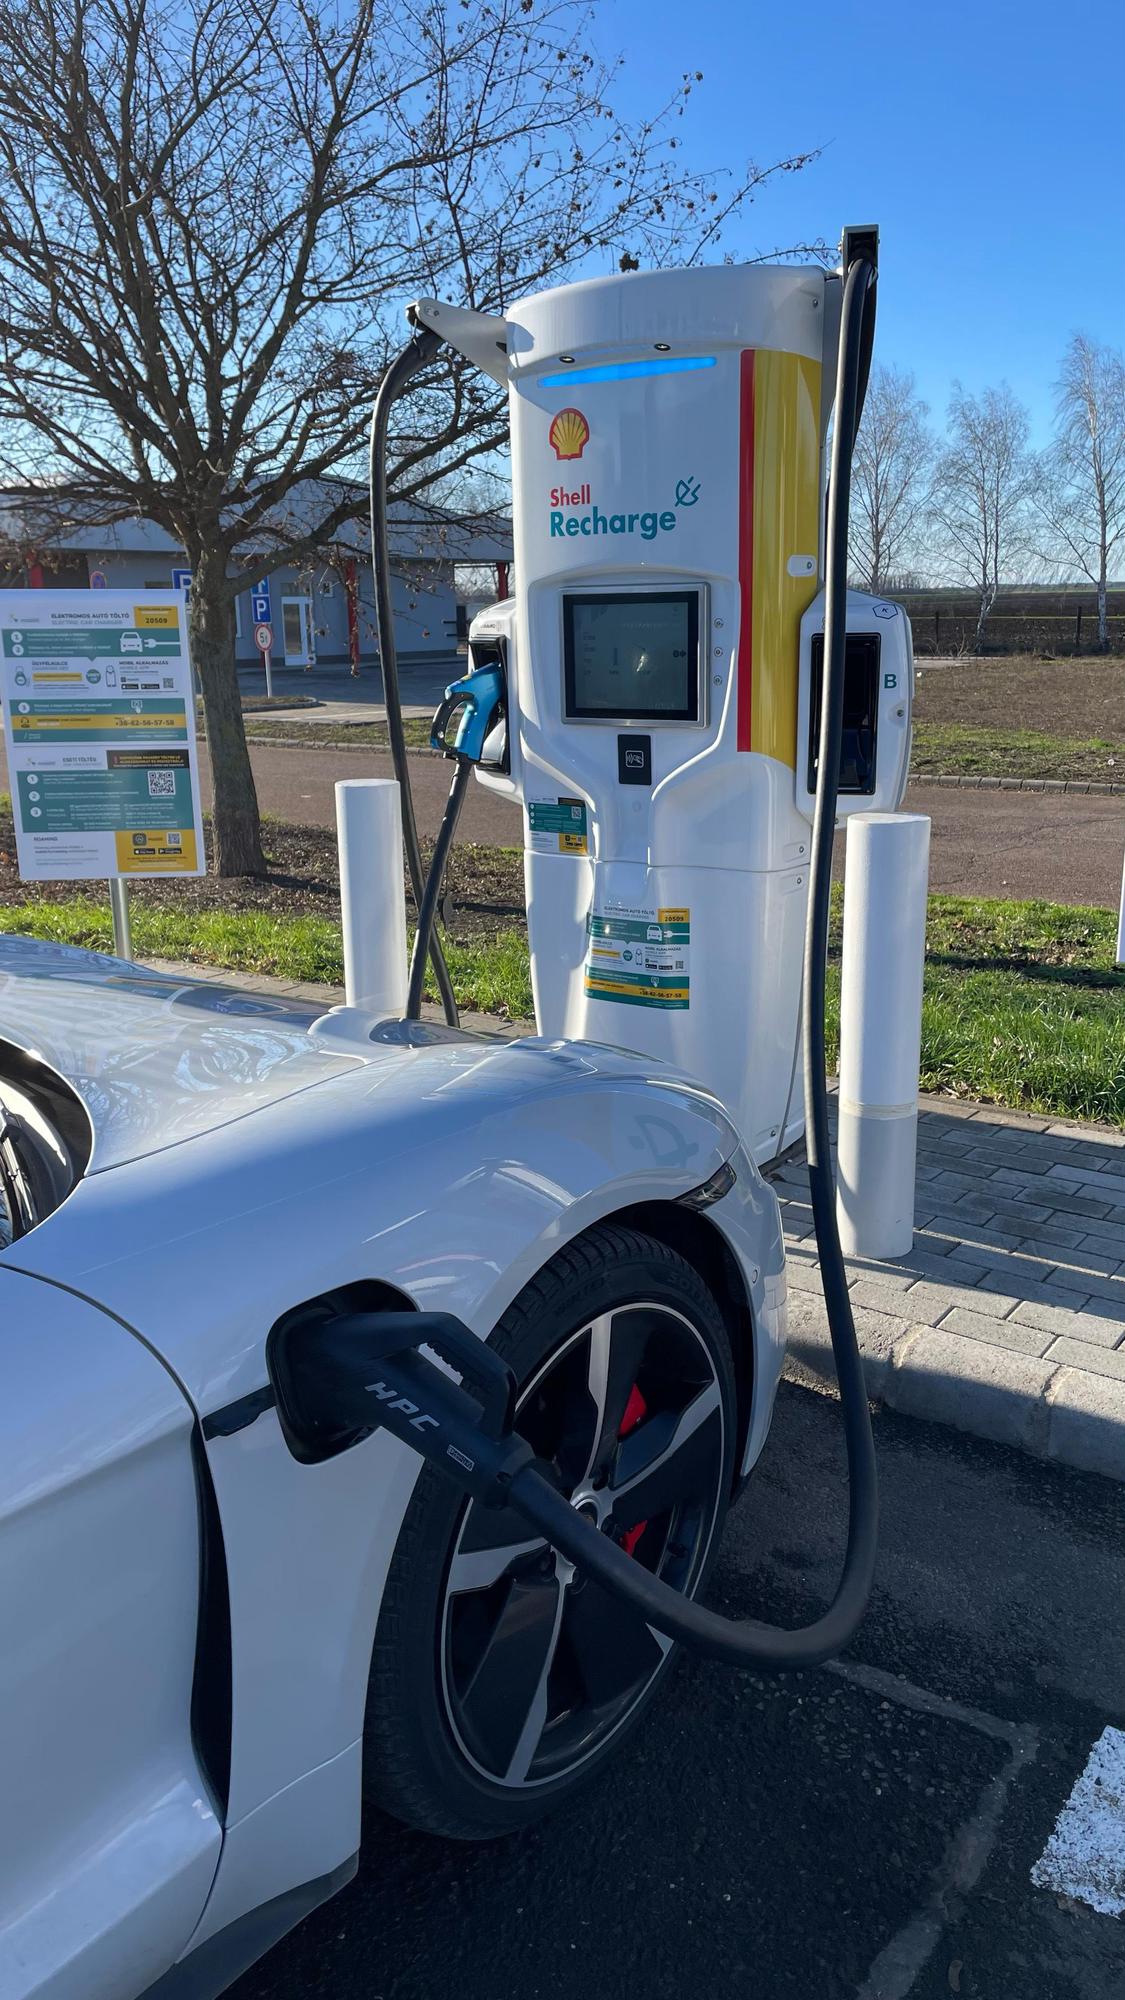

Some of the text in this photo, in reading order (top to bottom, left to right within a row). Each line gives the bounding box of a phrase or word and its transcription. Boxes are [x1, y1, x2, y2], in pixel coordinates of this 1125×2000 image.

[550, 484, 591, 507] Shell
[550, 506, 676, 540] Recharge
[179, 574, 193, 590] P
[256, 599, 266, 620] P
[884, 673, 897, 689] B
[364, 1381, 441, 1432] HPC
